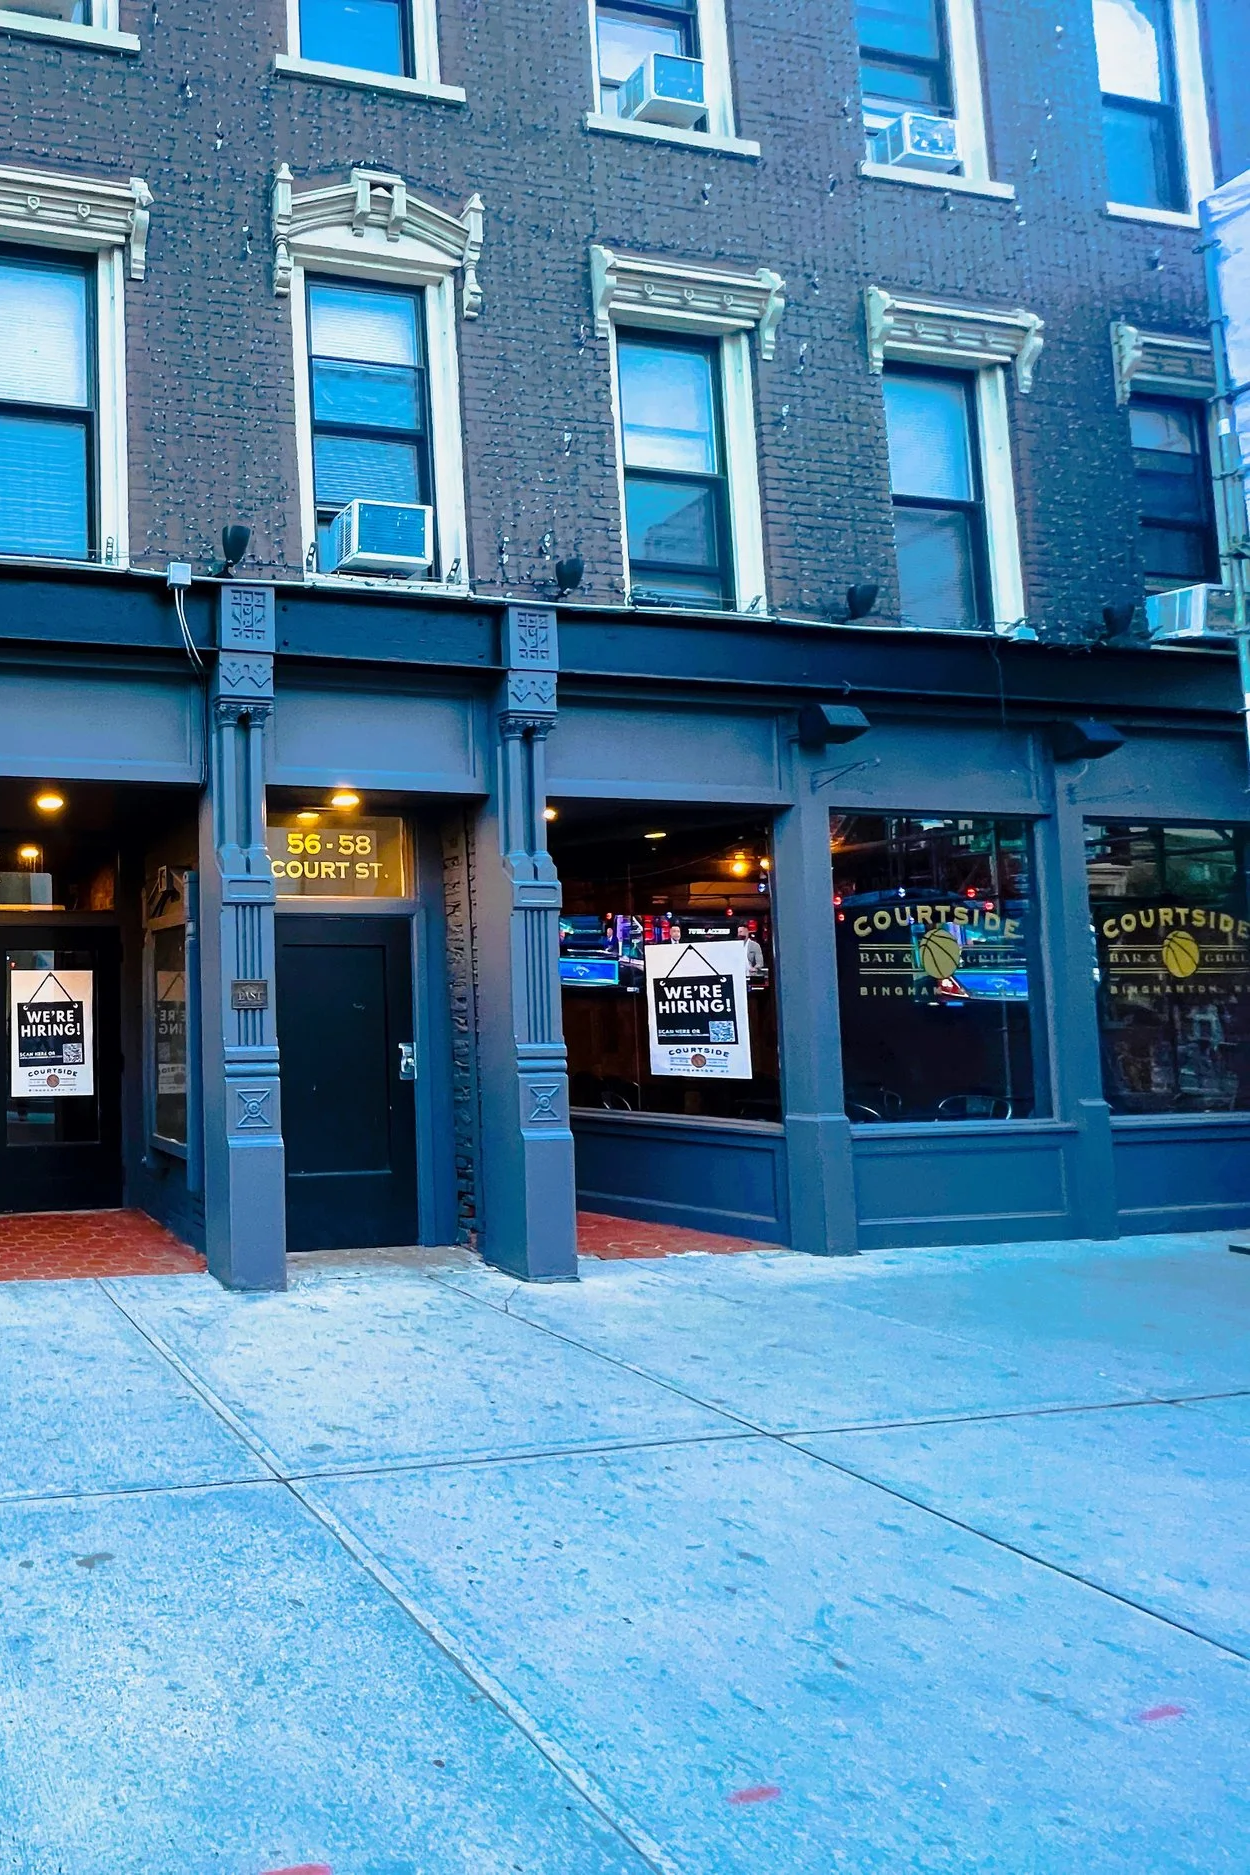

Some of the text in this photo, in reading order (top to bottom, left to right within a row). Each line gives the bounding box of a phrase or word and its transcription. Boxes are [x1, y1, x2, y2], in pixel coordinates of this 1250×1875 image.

[287, 833, 321, 855] 56
[338, 835, 372, 855] 58
[270, 860, 389, 879] COURT ST.
[853, 905, 1024, 938] COURTSIDE
[1103, 907, 1250, 938] COURTSIDE
[860, 952, 890, 963] BAR
[664, 985, 722, 999] WE'RE
[658, 998, 731, 1014] HIRING!
[26, 1010, 74, 1023] WE'RE
[21, 1023, 81, 1037] HIRING!
[669, 1048, 729, 1057] COURTSIDE
[28, 1068, 78, 1077] COURTSIDE
